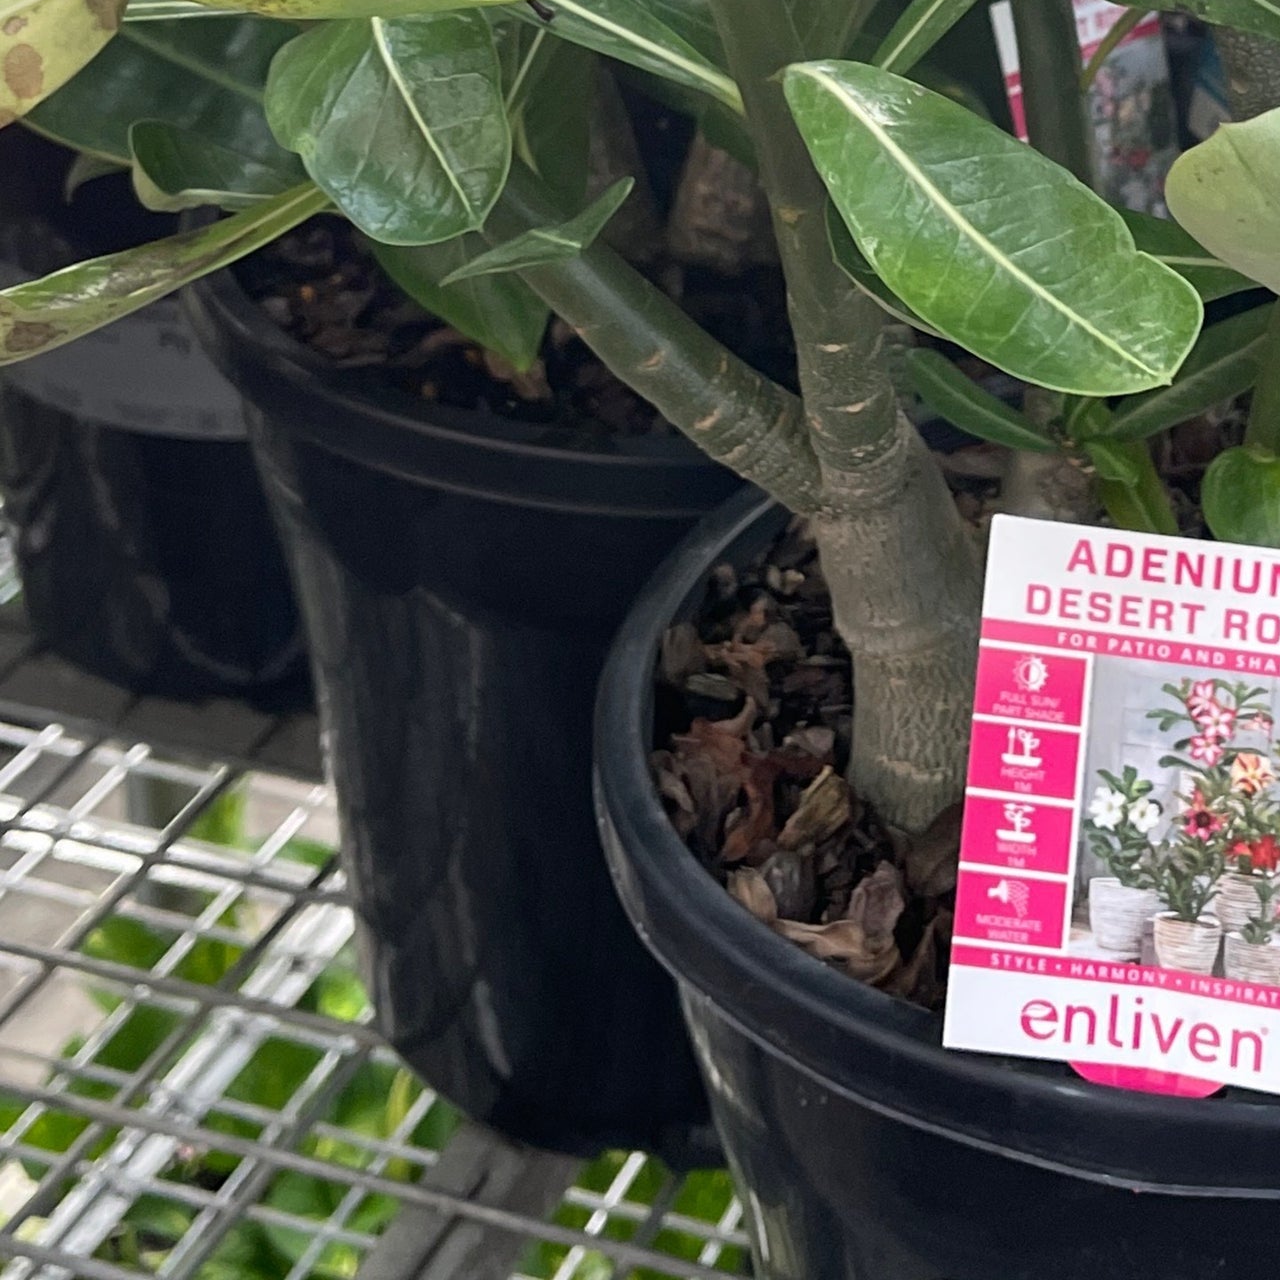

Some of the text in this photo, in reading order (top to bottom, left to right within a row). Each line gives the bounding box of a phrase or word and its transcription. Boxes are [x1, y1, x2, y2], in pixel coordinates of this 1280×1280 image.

[1025, 584, 1205, 634] DESERT
[1058, 632, 1098, 649] FOR
[1108, 636, 1170, 658] PATIO
[1181, 648, 1225, 665] AND
[1024, 707, 1064, 722] SHADE
[1000, 767, 1046, 781] HEIGHT
[996, 842, 1037, 856] WIDTH
[976, 914, 1042, 932] MODERATE
[988, 929, 1029, 943] WATER
[990, 953, 1047, 971] STYLE
[1071, 963, 1168, 987] HARMONY
[1021, 994, 1264, 1071] enliven
